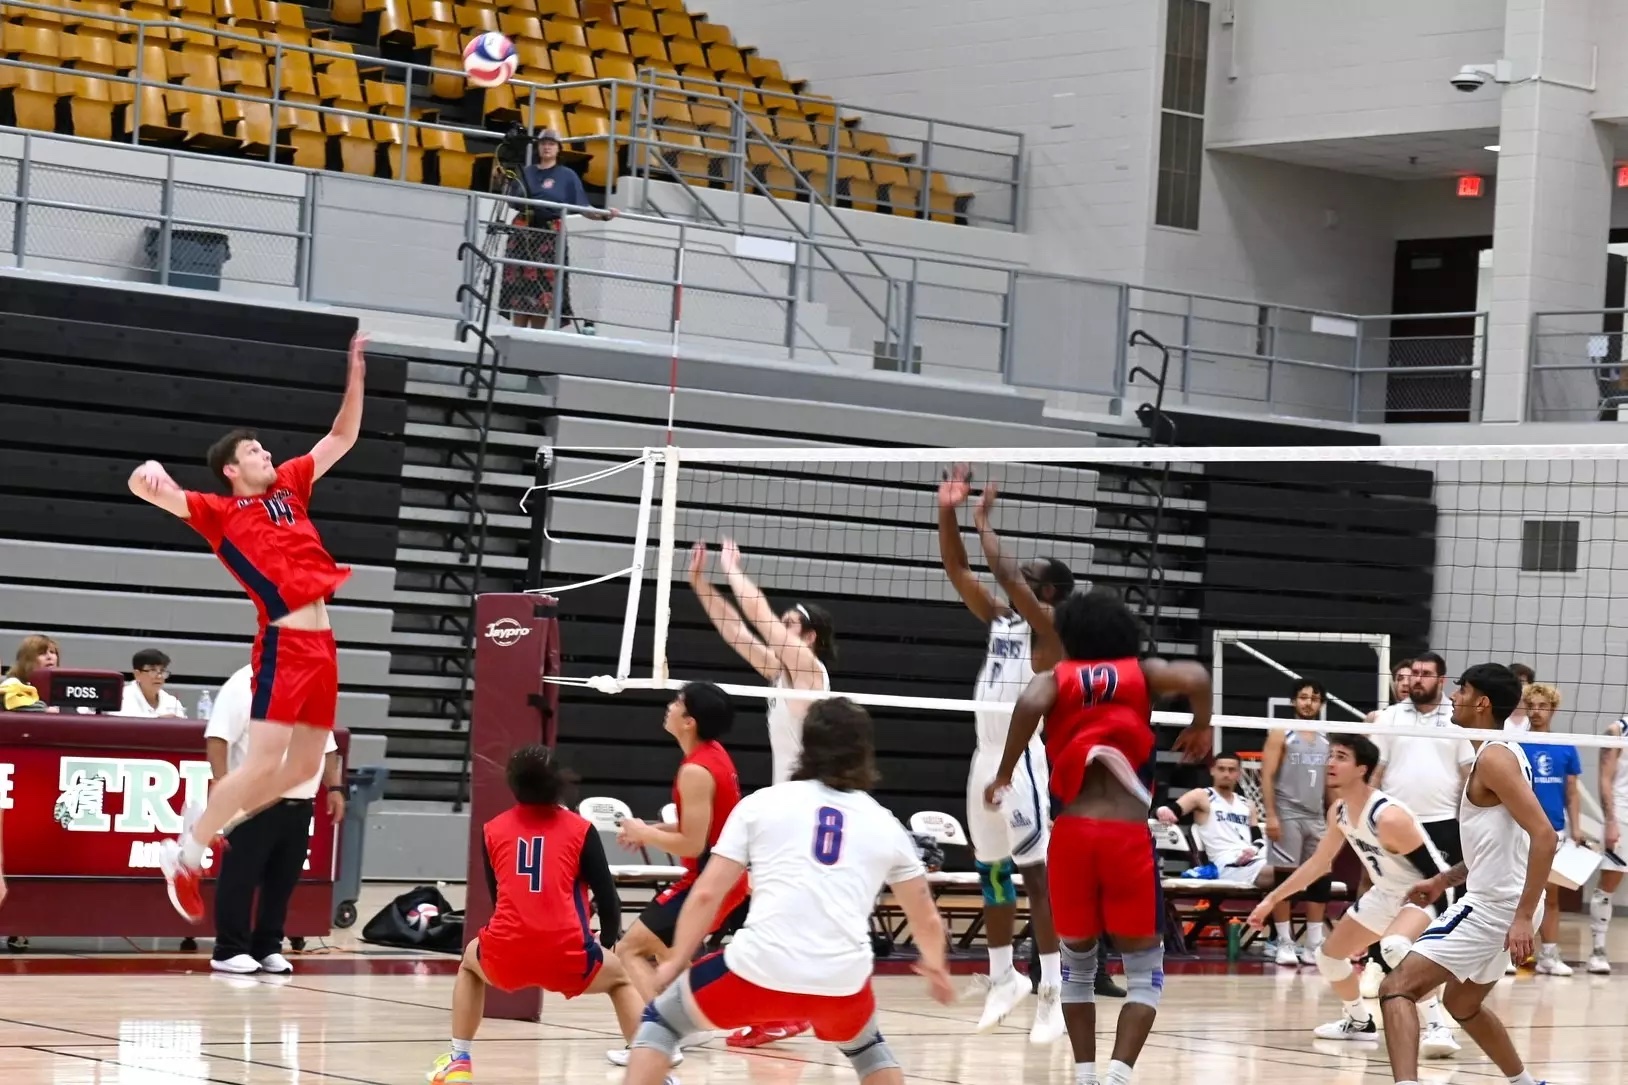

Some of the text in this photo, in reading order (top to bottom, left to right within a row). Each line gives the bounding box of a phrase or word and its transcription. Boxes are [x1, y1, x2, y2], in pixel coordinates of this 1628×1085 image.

[259, 498, 296, 527] 14
[484, 623, 530, 638] Jaypro
[66, 686, 99, 699] POSS.
[1307, 769, 1316, 788] 7
[814, 805, 845, 866] 8
[516, 836, 545, 893] 4
